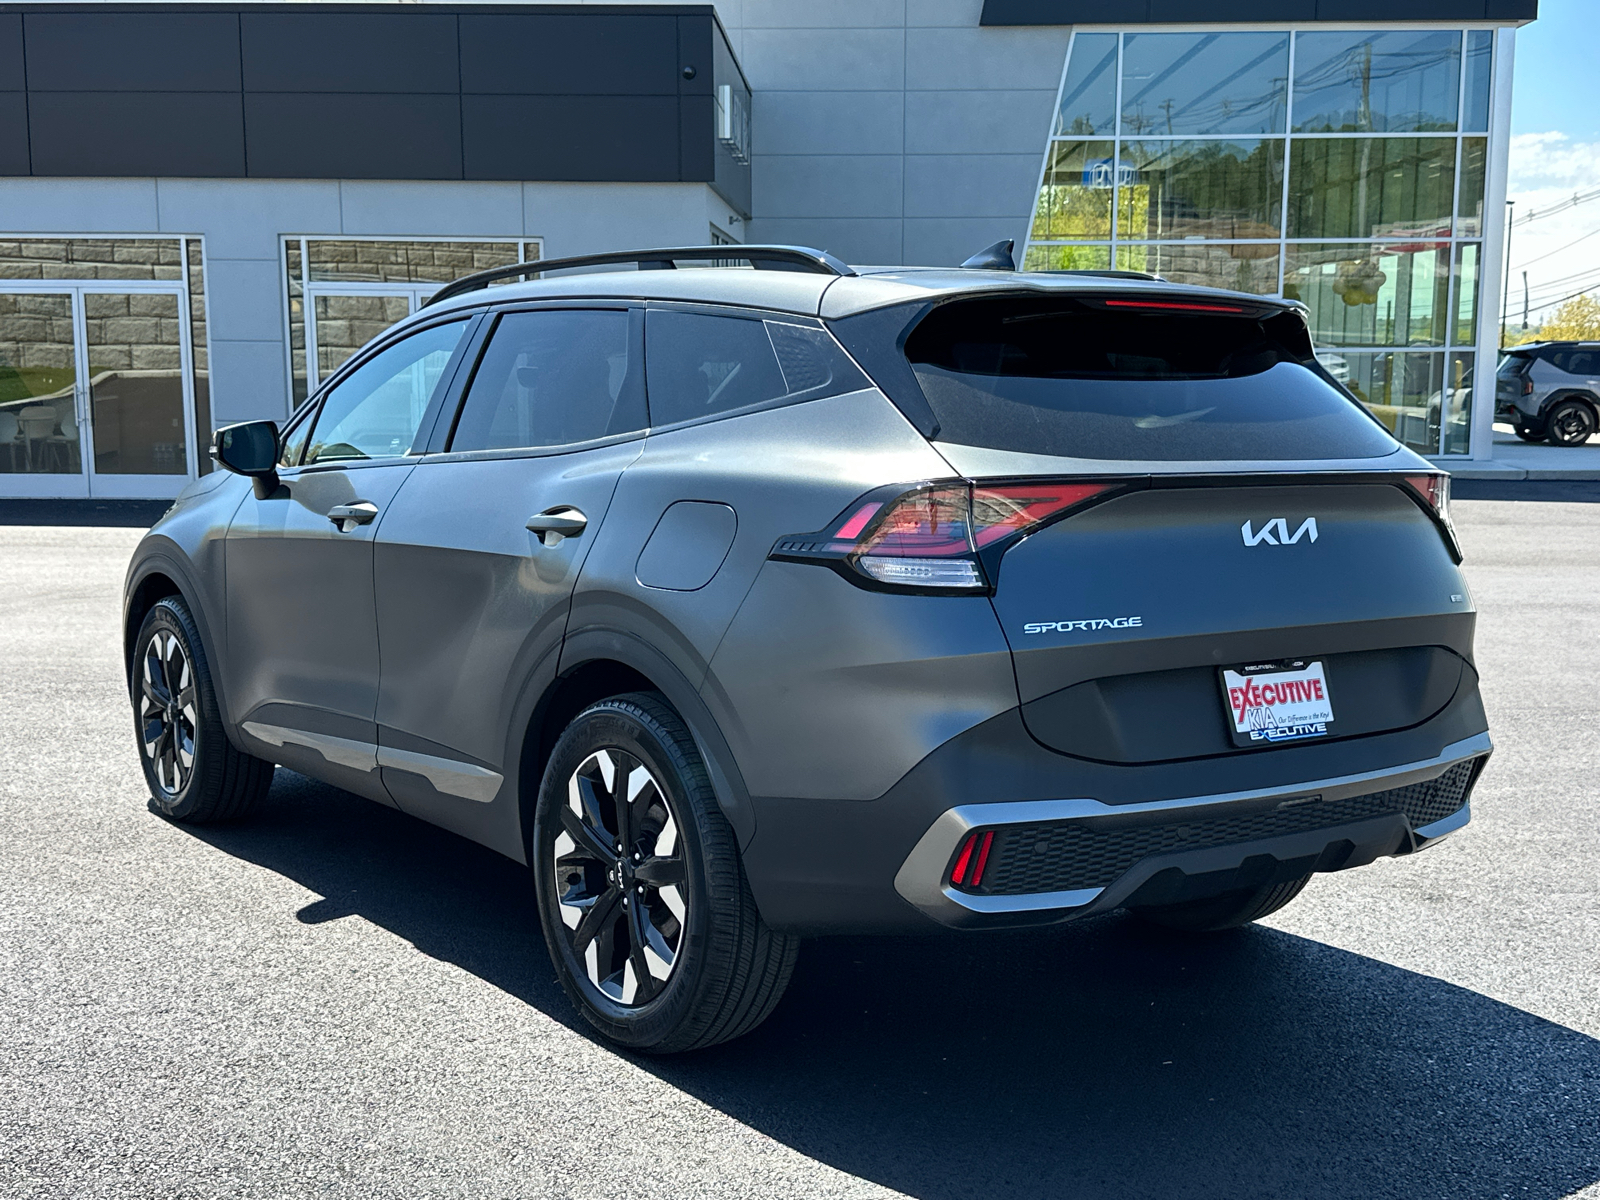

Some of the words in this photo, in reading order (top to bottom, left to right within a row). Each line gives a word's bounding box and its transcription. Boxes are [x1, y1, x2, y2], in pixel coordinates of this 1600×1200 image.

[1240, 517, 1319, 547] KIA
[1023, 616, 1143, 635] SPORTAGE
[1229, 677, 1325, 725] EXECUTIVE
[1247, 706, 1279, 731] KIA
[1278, 716, 1287, 724] Our
[1249, 722, 1327, 741] EXECUTIVE
